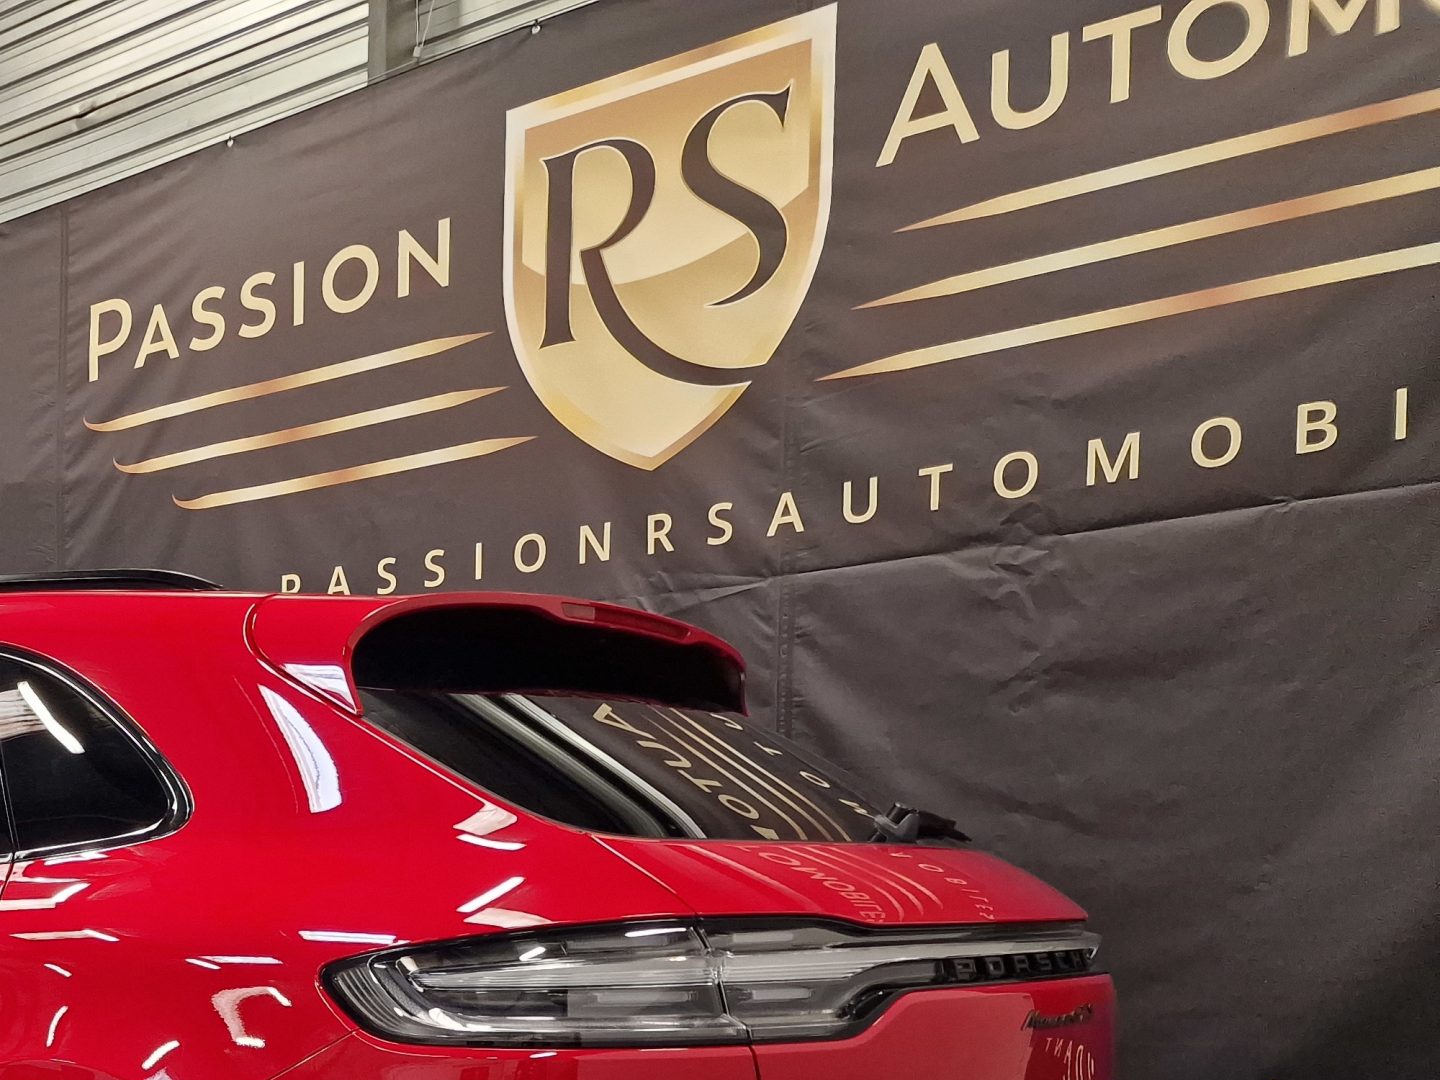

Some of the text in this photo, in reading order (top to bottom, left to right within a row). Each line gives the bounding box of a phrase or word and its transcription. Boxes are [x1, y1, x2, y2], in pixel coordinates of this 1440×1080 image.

[88, 0, 1440, 387] PASSION RS AUTOM
